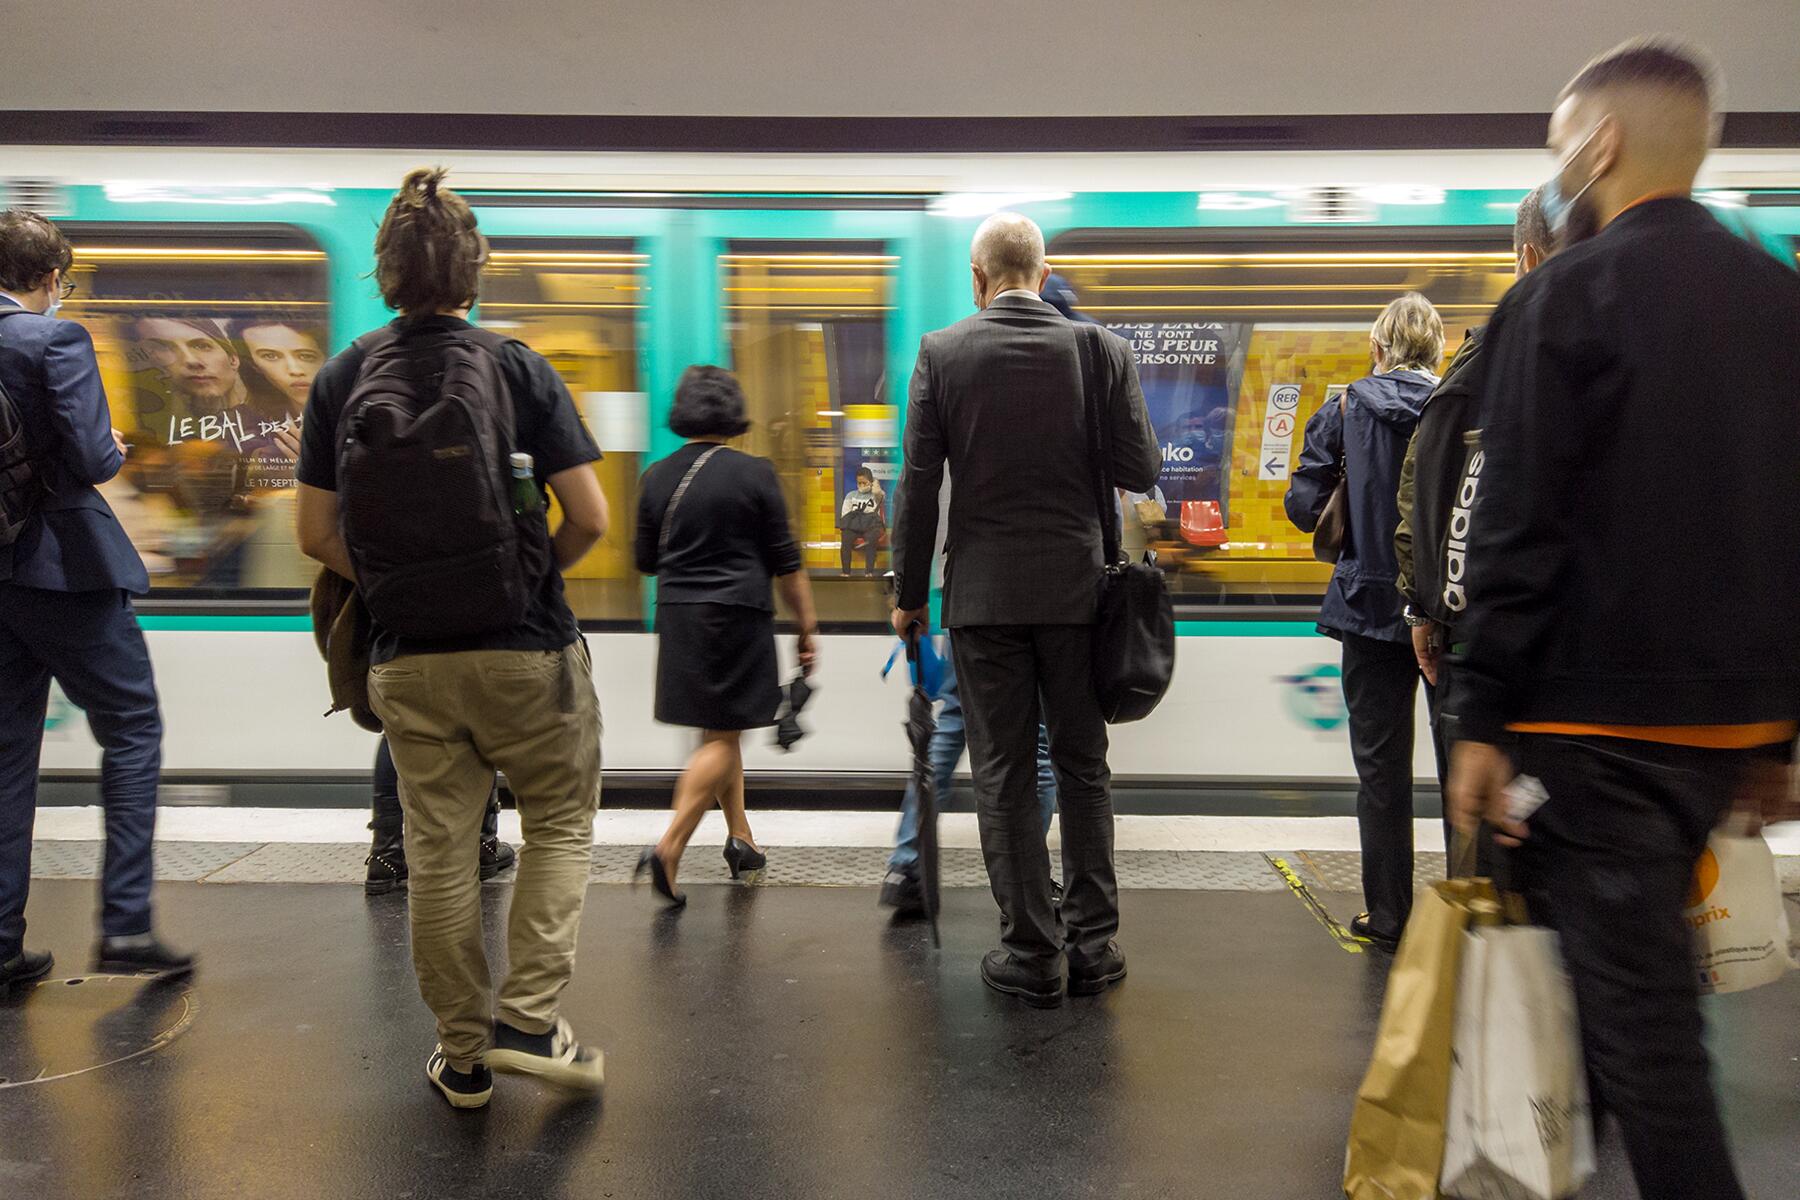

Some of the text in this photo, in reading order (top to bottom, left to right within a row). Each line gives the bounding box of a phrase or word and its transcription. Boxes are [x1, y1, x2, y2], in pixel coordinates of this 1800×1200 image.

[1134, 330, 1194, 339] NE FONT
[1130, 339, 1219, 352] US PEUR
[1134, 353, 1217, 365] ERSONNE
[1276, 393, 1298, 403] RER
[1275, 419, 1288, 431] A
[167, 415, 196, 446] LE
[198, 409, 256, 454] BAL
[258, 415, 292, 437] DES
[1162, 441, 1194, 462] ko
[269, 456, 299, 464] MÉLANI
[1171, 465, 1204, 473] habitation
[258, 479, 269, 488] 17
[271, 478, 299, 488] SEPTE
[1443, 450, 1486, 612] adidas
[1689, 905, 1731, 928] prix
